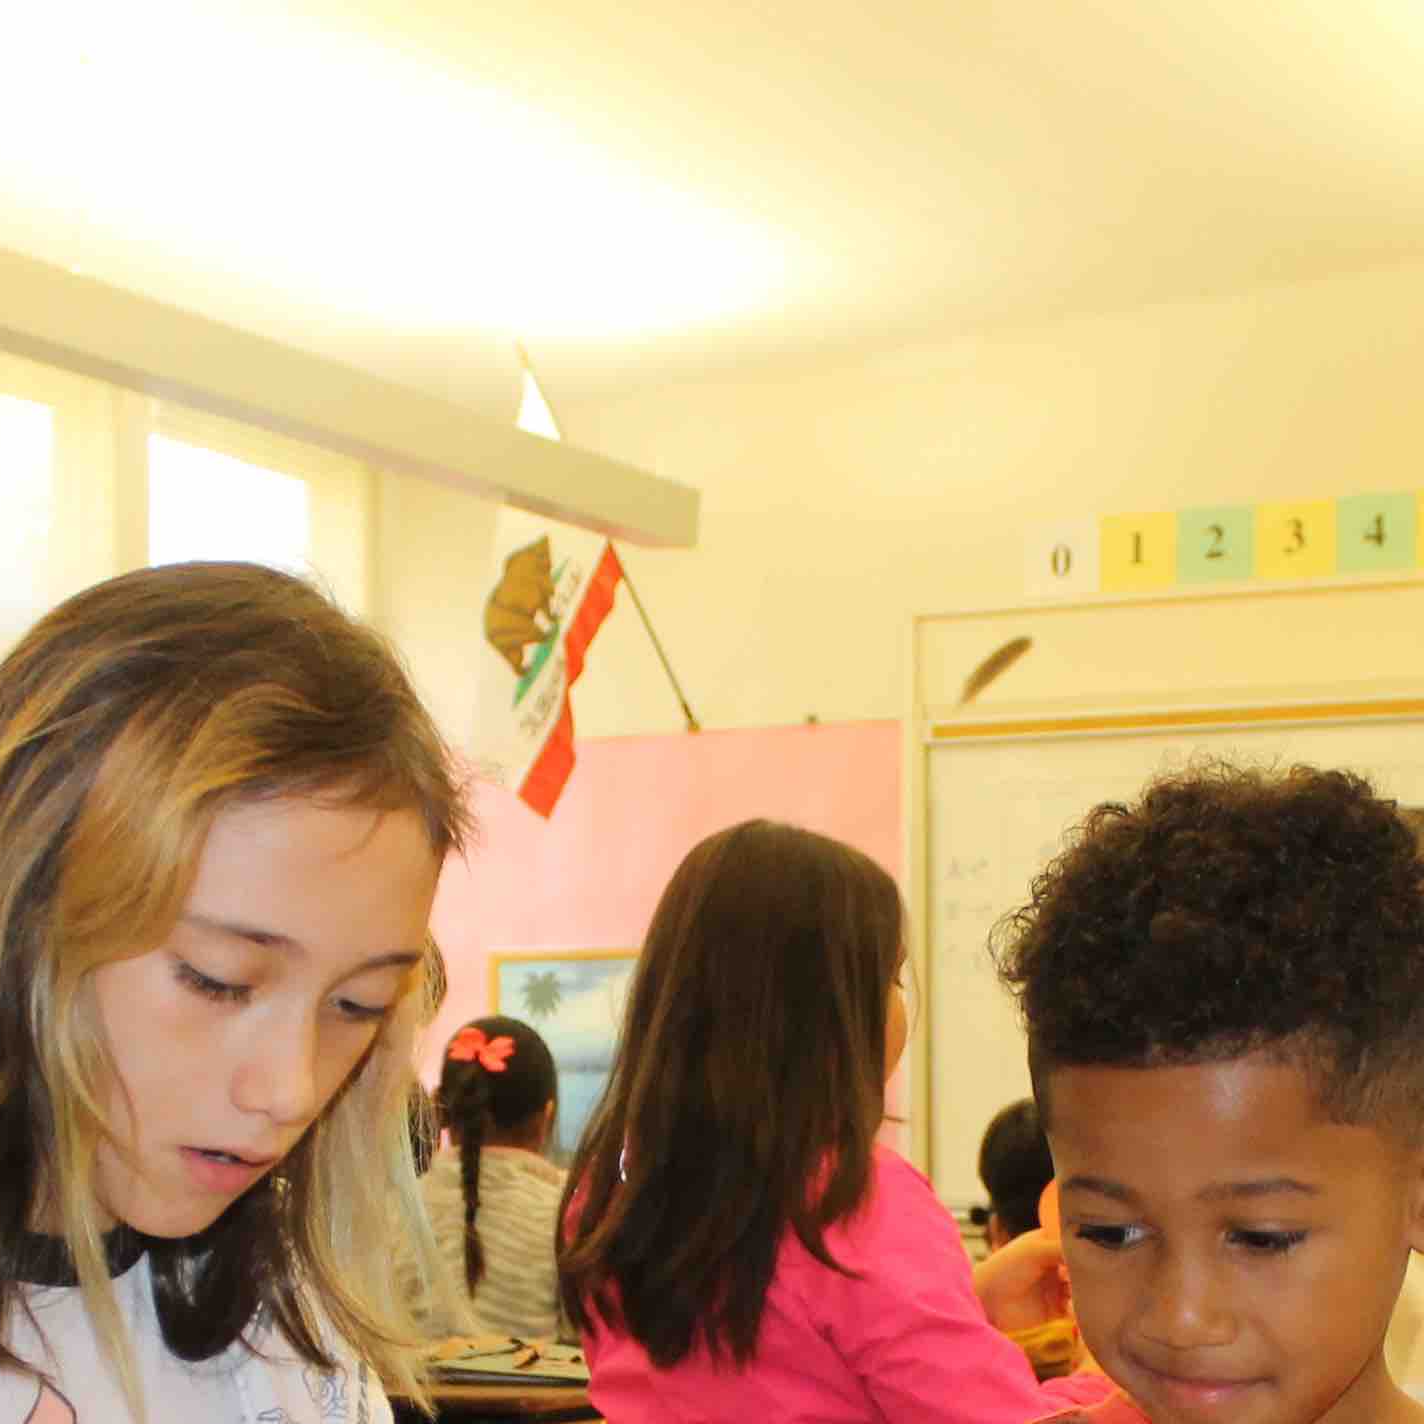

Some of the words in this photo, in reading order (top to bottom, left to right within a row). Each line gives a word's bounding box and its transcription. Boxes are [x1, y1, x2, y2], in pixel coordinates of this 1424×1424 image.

[1050, 543, 1073, 578] 0
[1130, 530, 1144, 566] 1
[1203, 523, 1226, 560] 2
[1282, 516, 1306, 556] 3
[1361, 511, 1388, 548] 4
